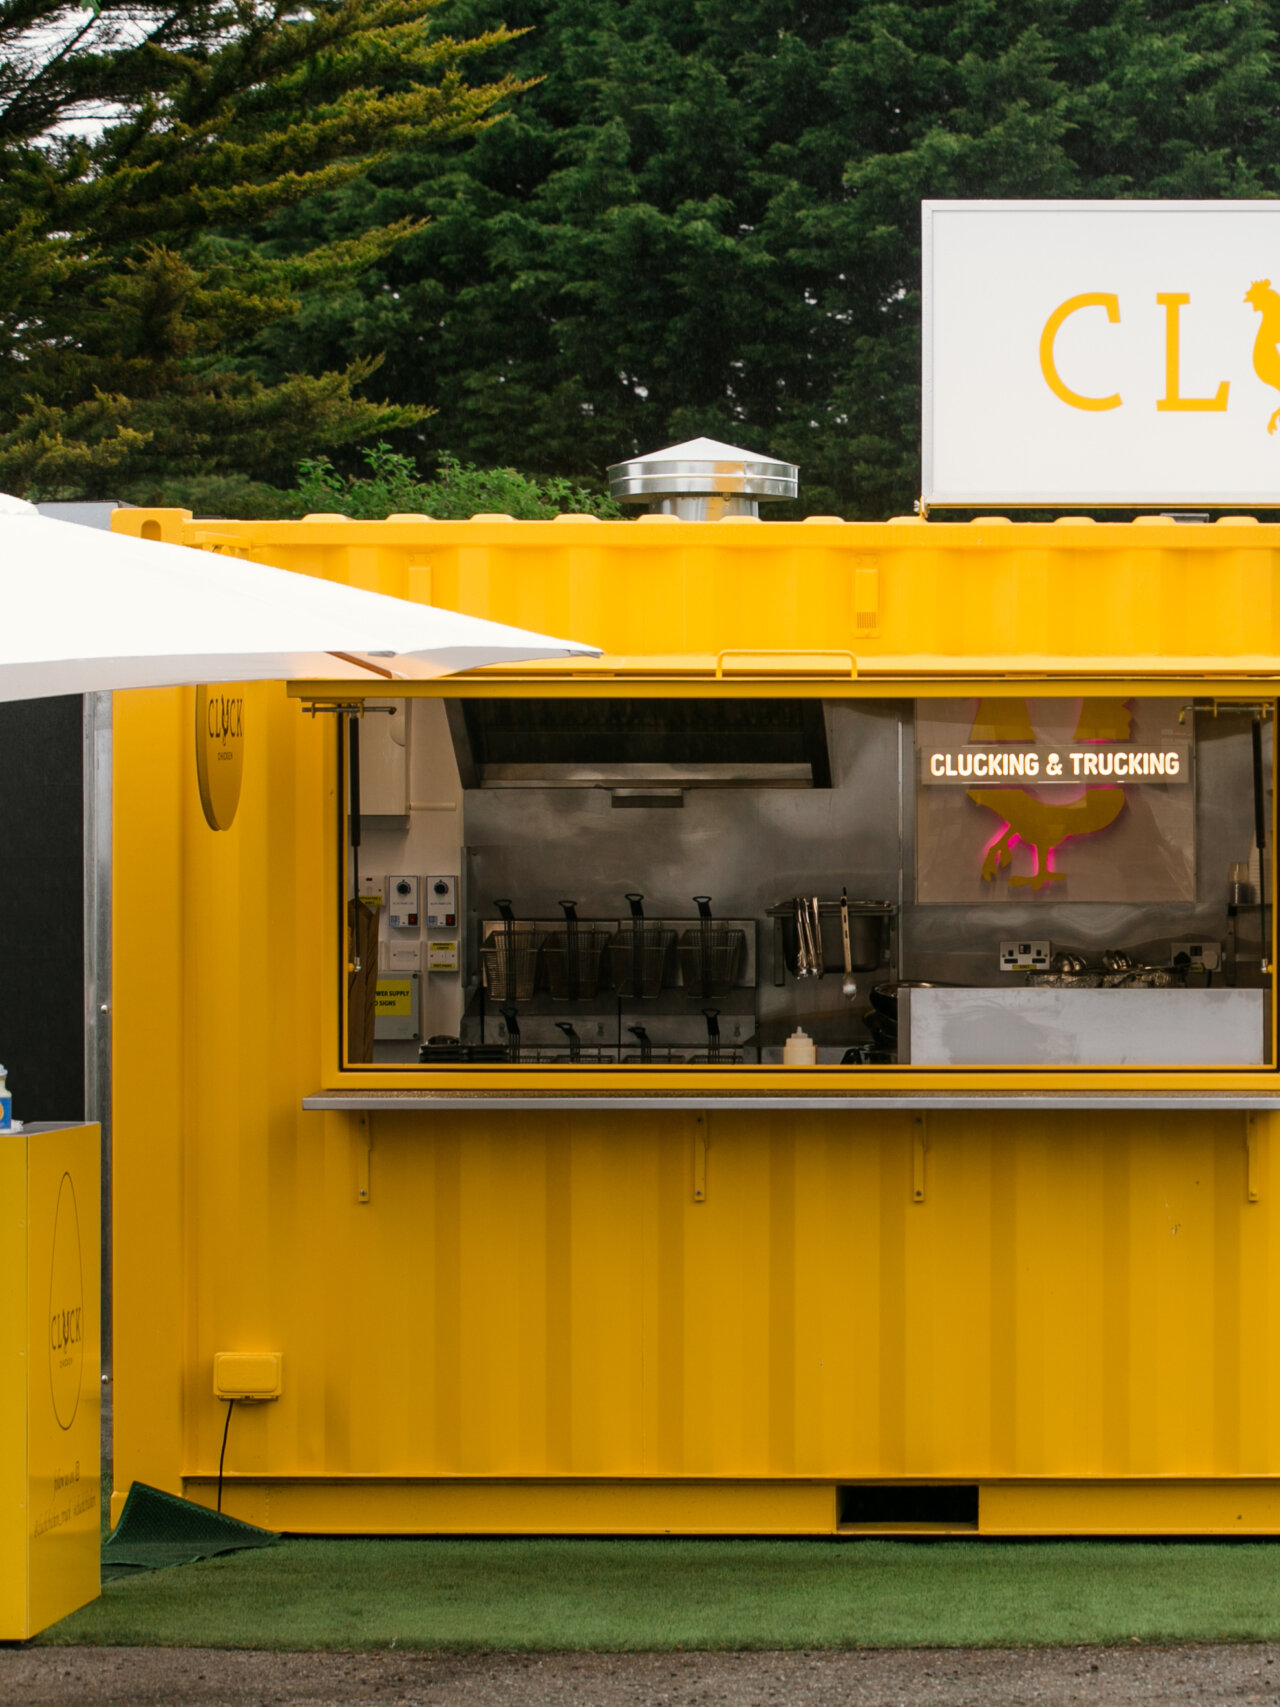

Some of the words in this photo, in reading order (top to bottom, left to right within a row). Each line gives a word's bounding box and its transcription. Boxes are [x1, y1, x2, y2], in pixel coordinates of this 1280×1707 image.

[930, 752, 1040, 777] CLUCKING
[1046, 753, 1063, 776] &
[1069, 752, 1180, 776] TRUCKING
